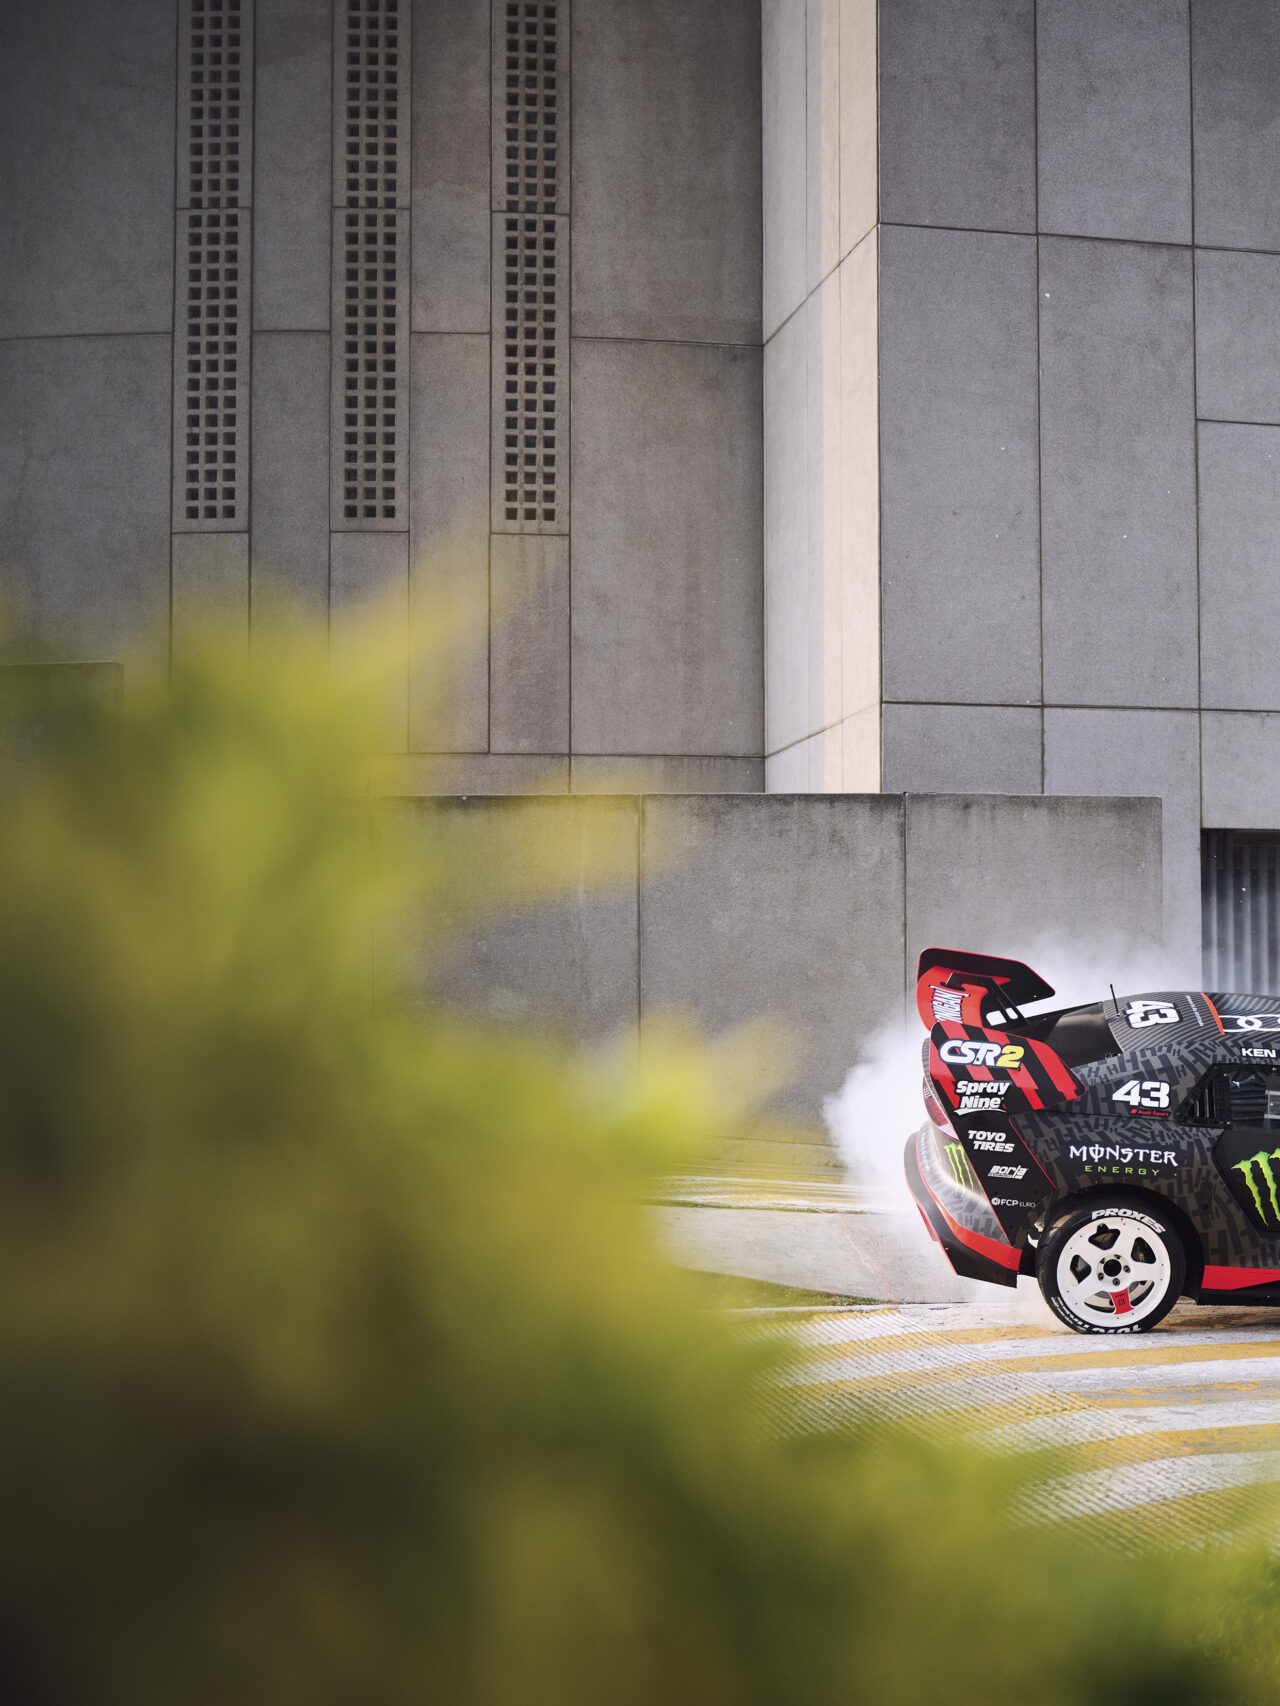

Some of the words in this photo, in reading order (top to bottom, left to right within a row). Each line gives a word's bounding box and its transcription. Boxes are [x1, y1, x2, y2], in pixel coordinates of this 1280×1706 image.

[1125, 1000, 1180, 1028] 43
[940, 1039, 1024, 1069] CSR2
[1241, 1047, 1277, 1058] KEN
[956, 1080, 1010, 1095] Spray
[1112, 1080, 1170, 1108] 43
[960, 1095, 1002, 1109] Nine
[968, 1129, 1007, 1142] TOYO
[973, 1140, 1015, 1153] TIRES
[1069, 1144, 1179, 1167] MONSTER
[1084, 1165, 1160, 1176] ENERGY
[1000, 1198, 1019, 1207] FCP
[1091, 1207, 1167, 1234] PROXES
